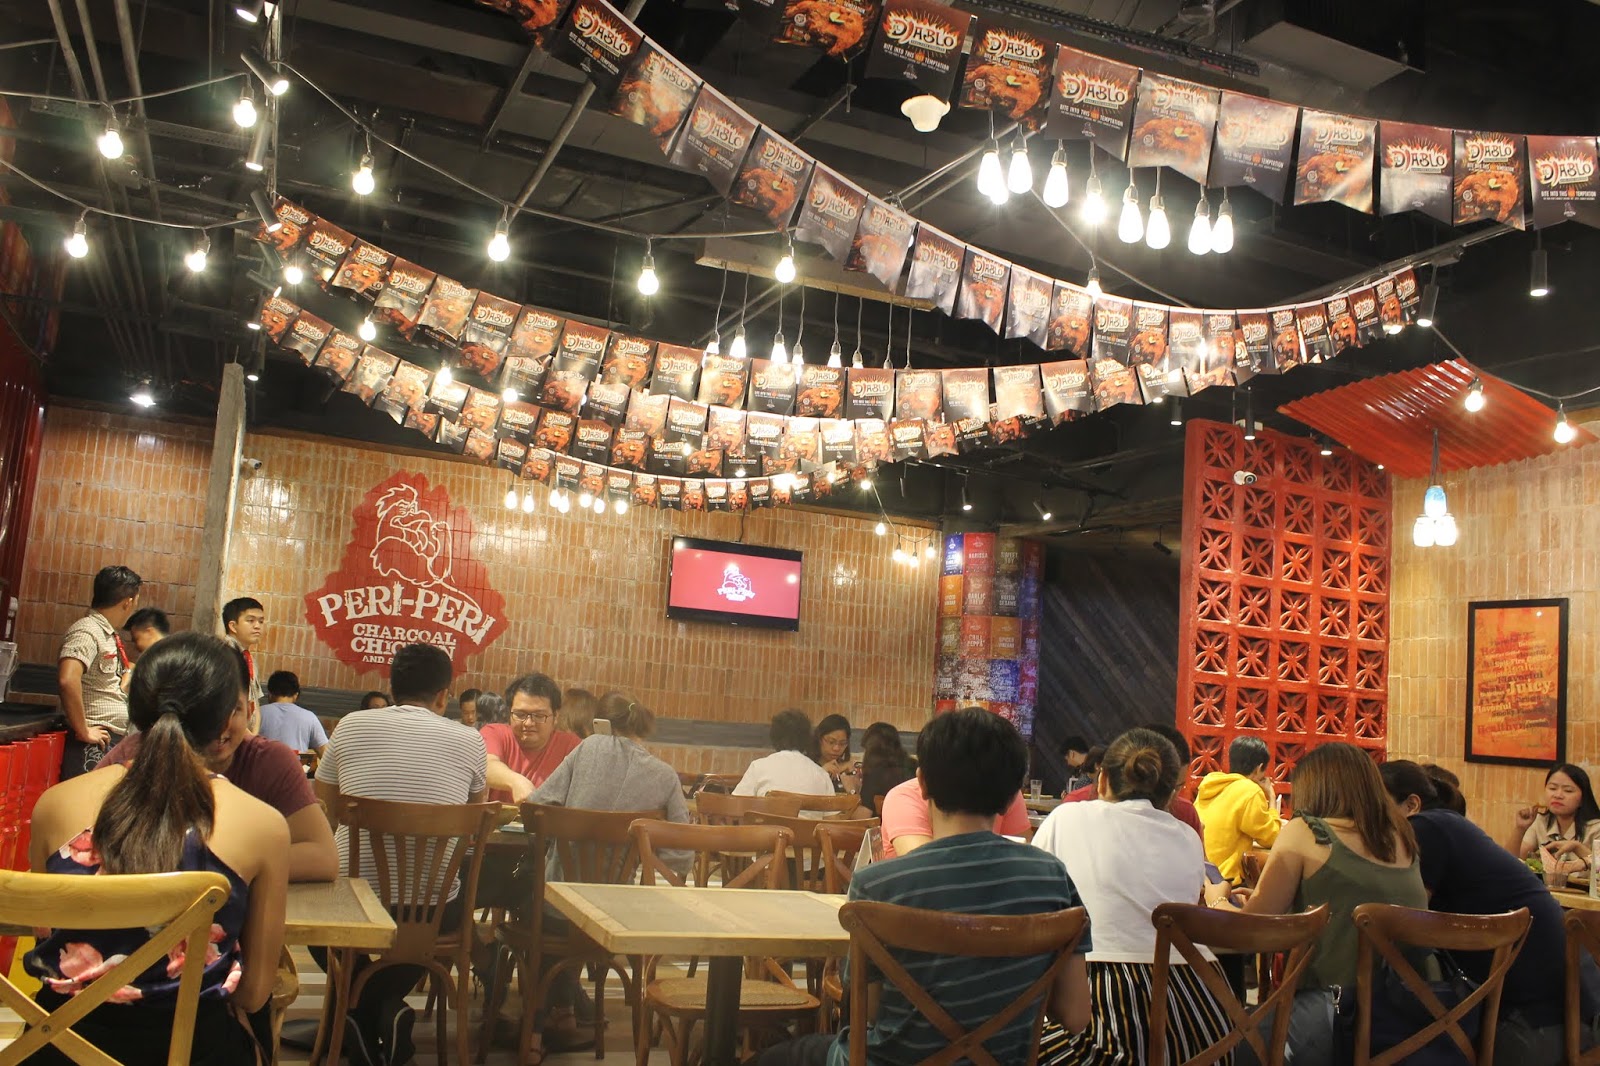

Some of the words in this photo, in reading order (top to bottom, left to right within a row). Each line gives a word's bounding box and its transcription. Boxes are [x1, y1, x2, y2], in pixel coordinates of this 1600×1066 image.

[317, 581, 496, 645] PERI-PERI
[352, 623, 457, 646] CHARCOAL
[350, 636, 456, 662] CHICN
[362, 655, 385, 665] AND
[1506, 678, 1552, 694] Juicy
